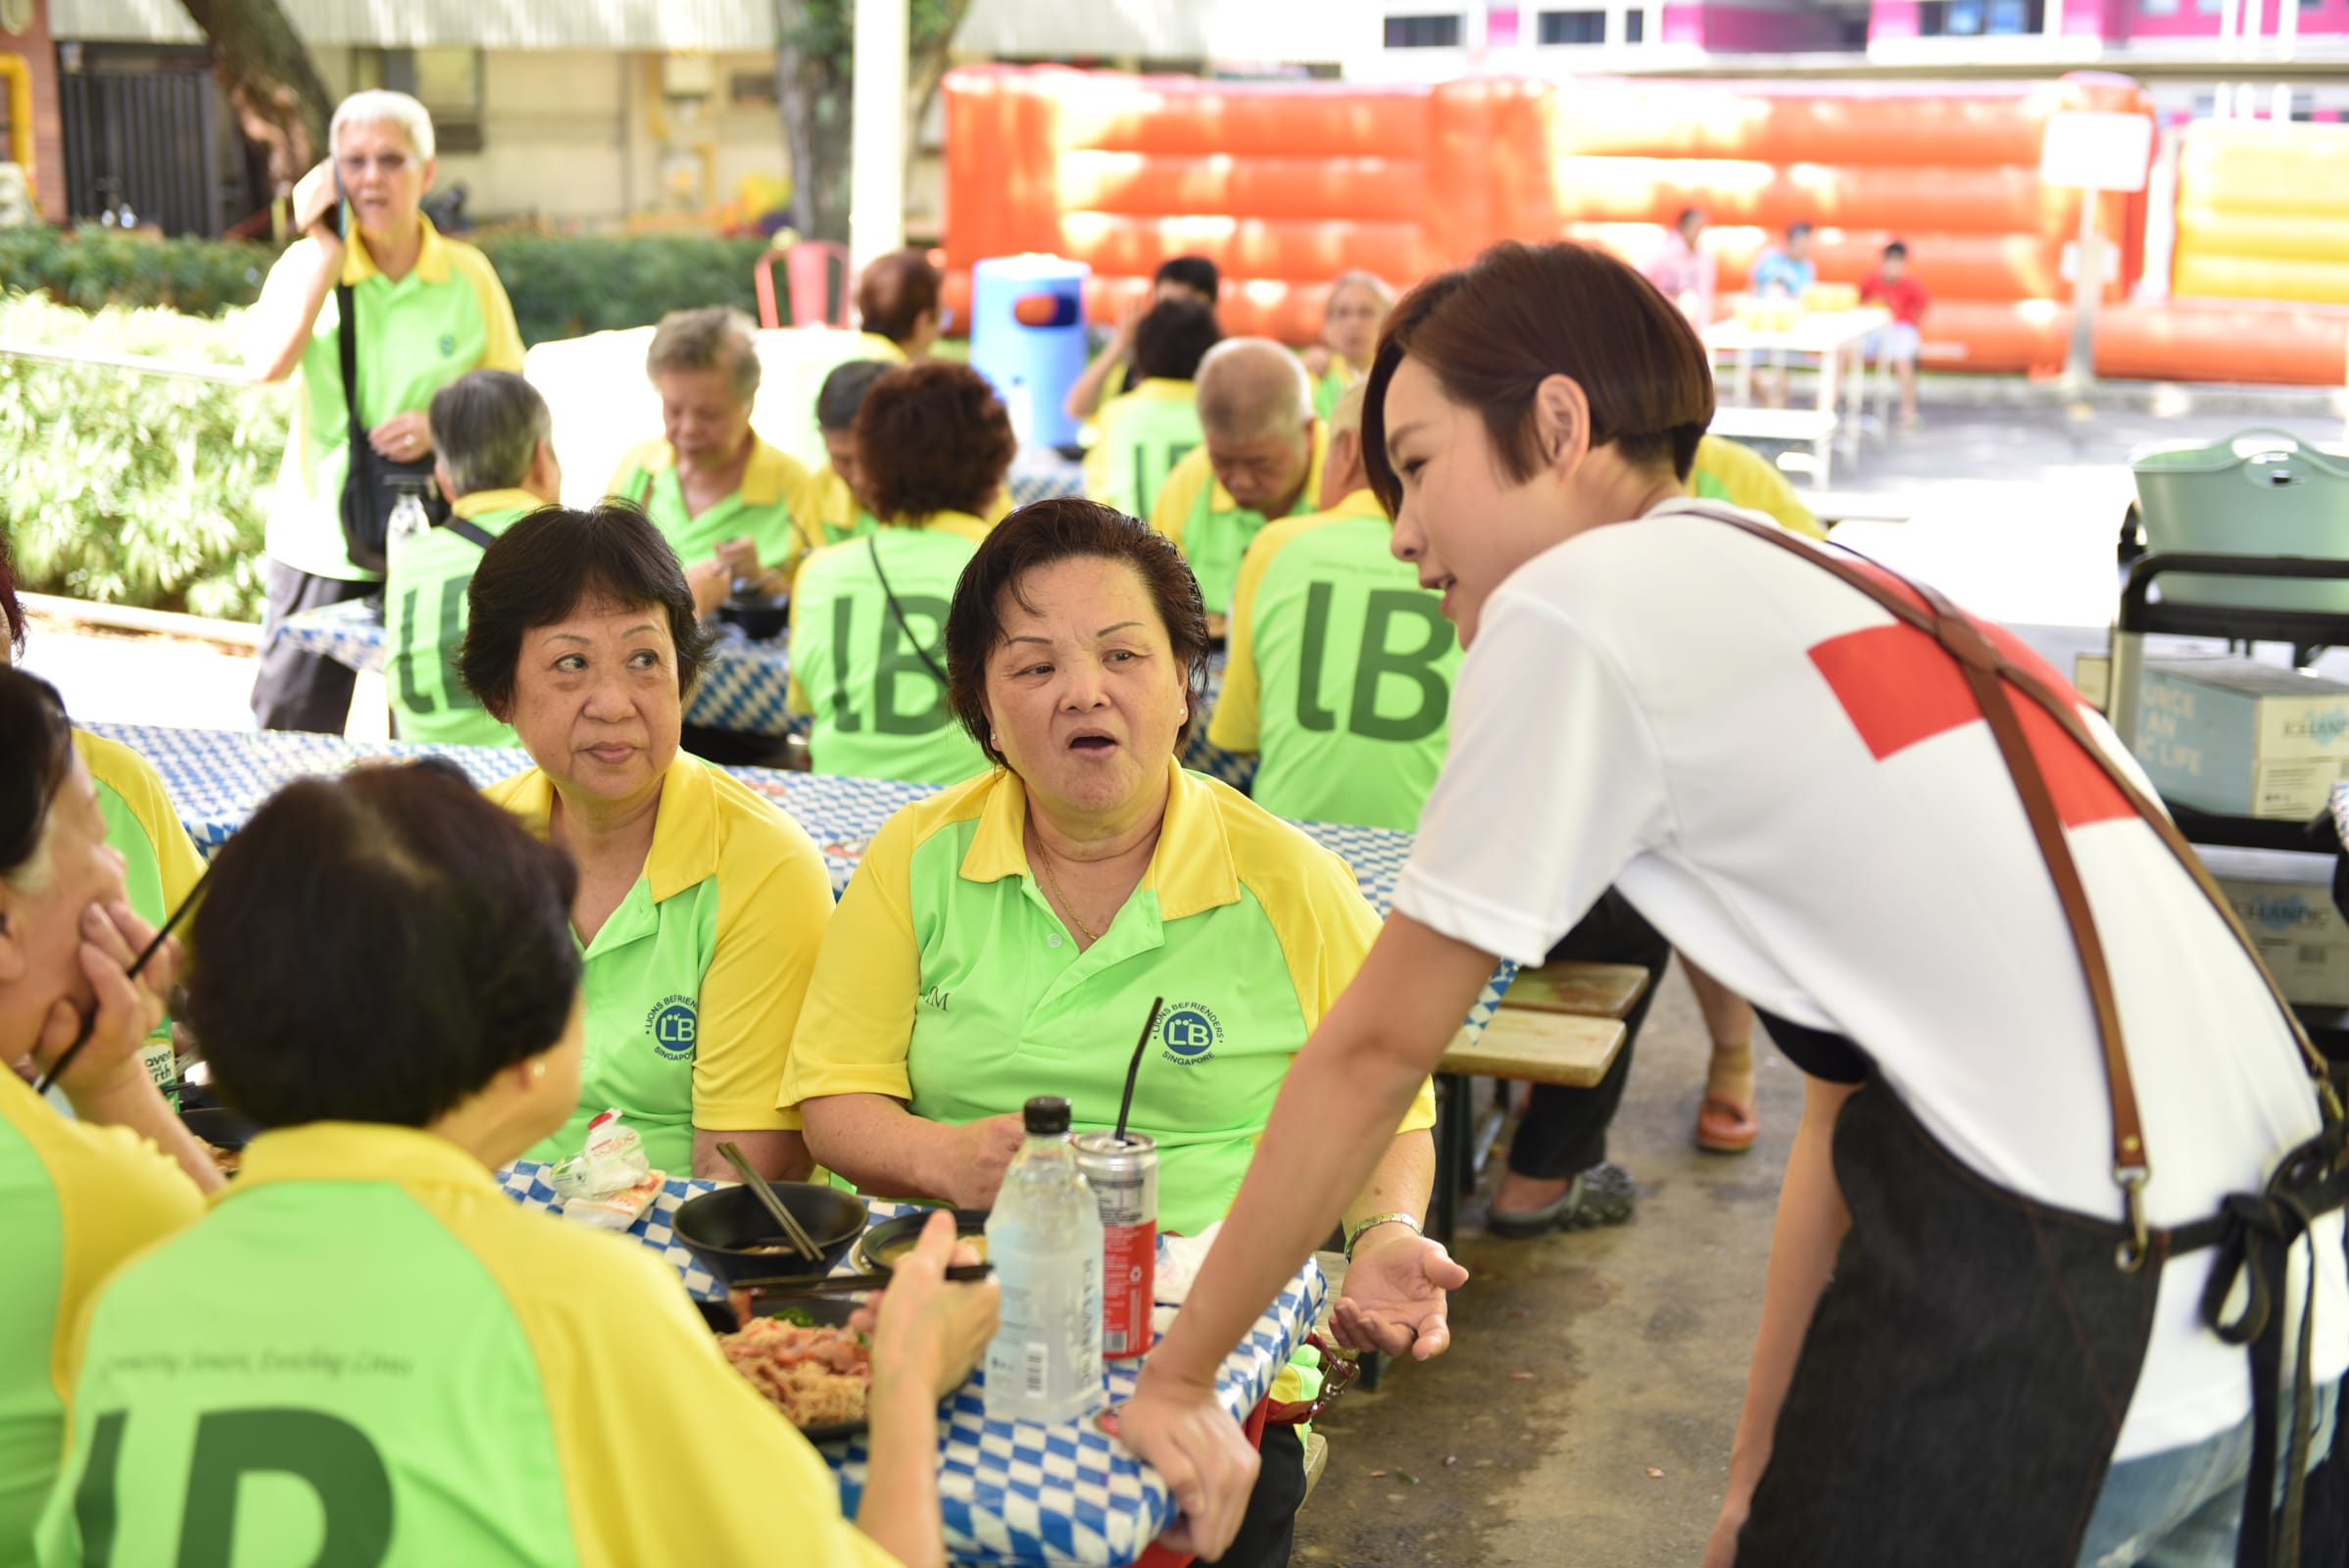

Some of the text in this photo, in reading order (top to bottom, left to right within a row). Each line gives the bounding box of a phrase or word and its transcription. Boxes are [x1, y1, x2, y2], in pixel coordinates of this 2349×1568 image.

[1296, 580, 1455, 743] LB
[645, 1002, 664, 1029] LIONS
[1152, 1002, 1225, 1039] LIONS BEFRIENDERS
[654, 1046, 694, 1061] SINGAPO
[1161, 1051, 1216, 1066] SINGAPORE
